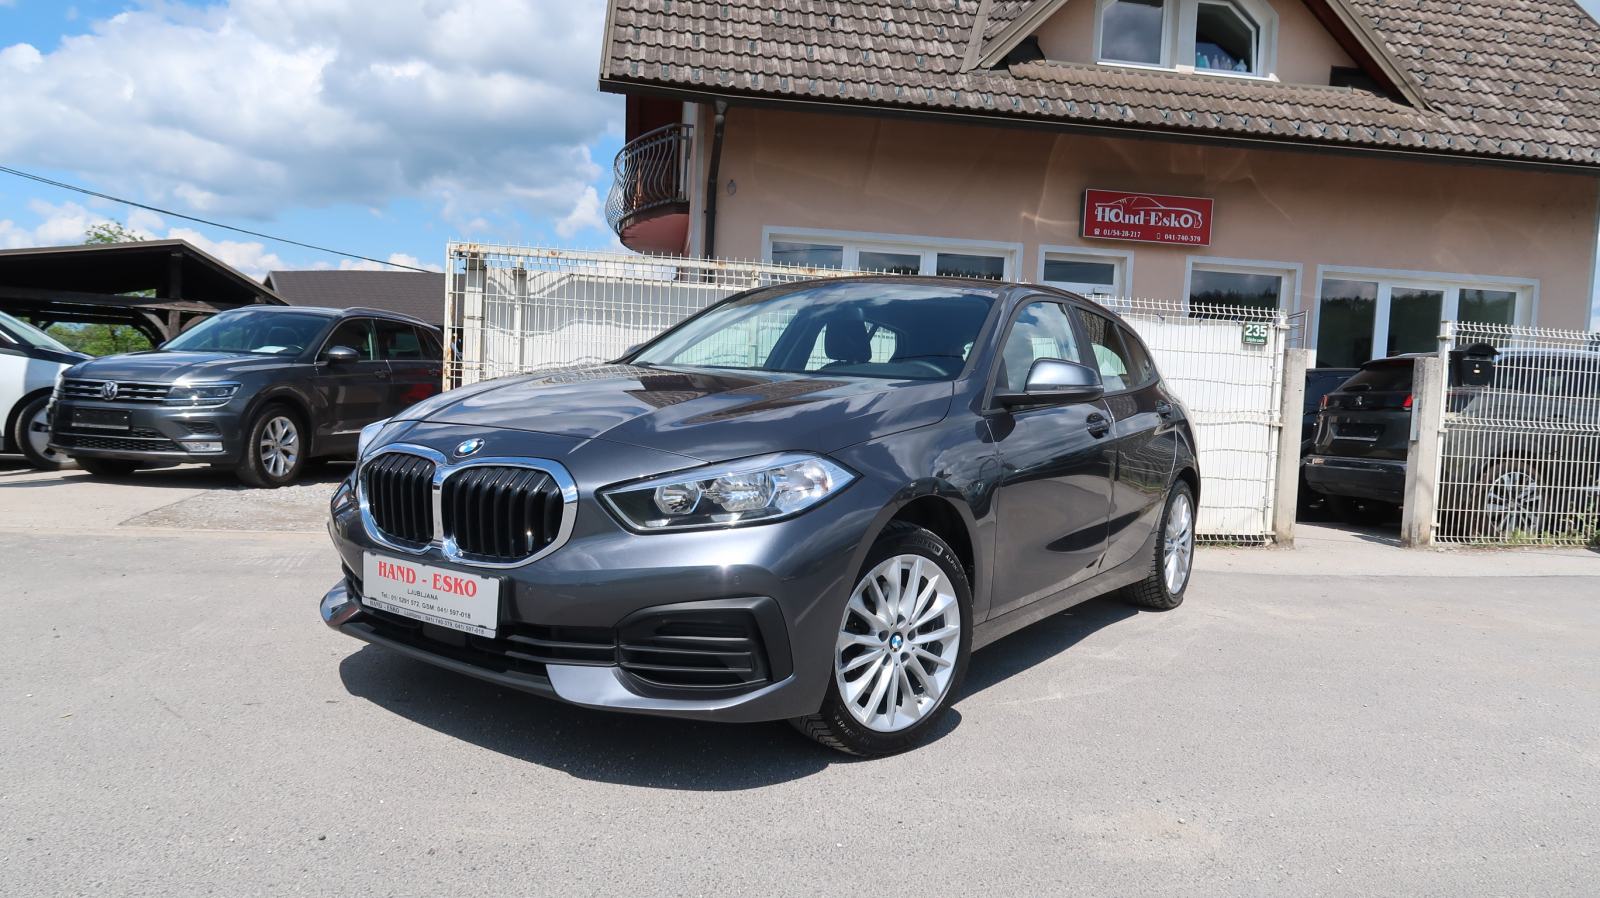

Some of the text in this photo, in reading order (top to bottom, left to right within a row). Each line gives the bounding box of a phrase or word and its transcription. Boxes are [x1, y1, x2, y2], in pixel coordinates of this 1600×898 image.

[1245, 324, 1268, 338] 235
[378, 561, 416, 584] HAND
[432, 573, 476, 597] ESKO
[407, 588, 439, 601] LJUBLJANA
[449, 607, 472, 620] 597-018
